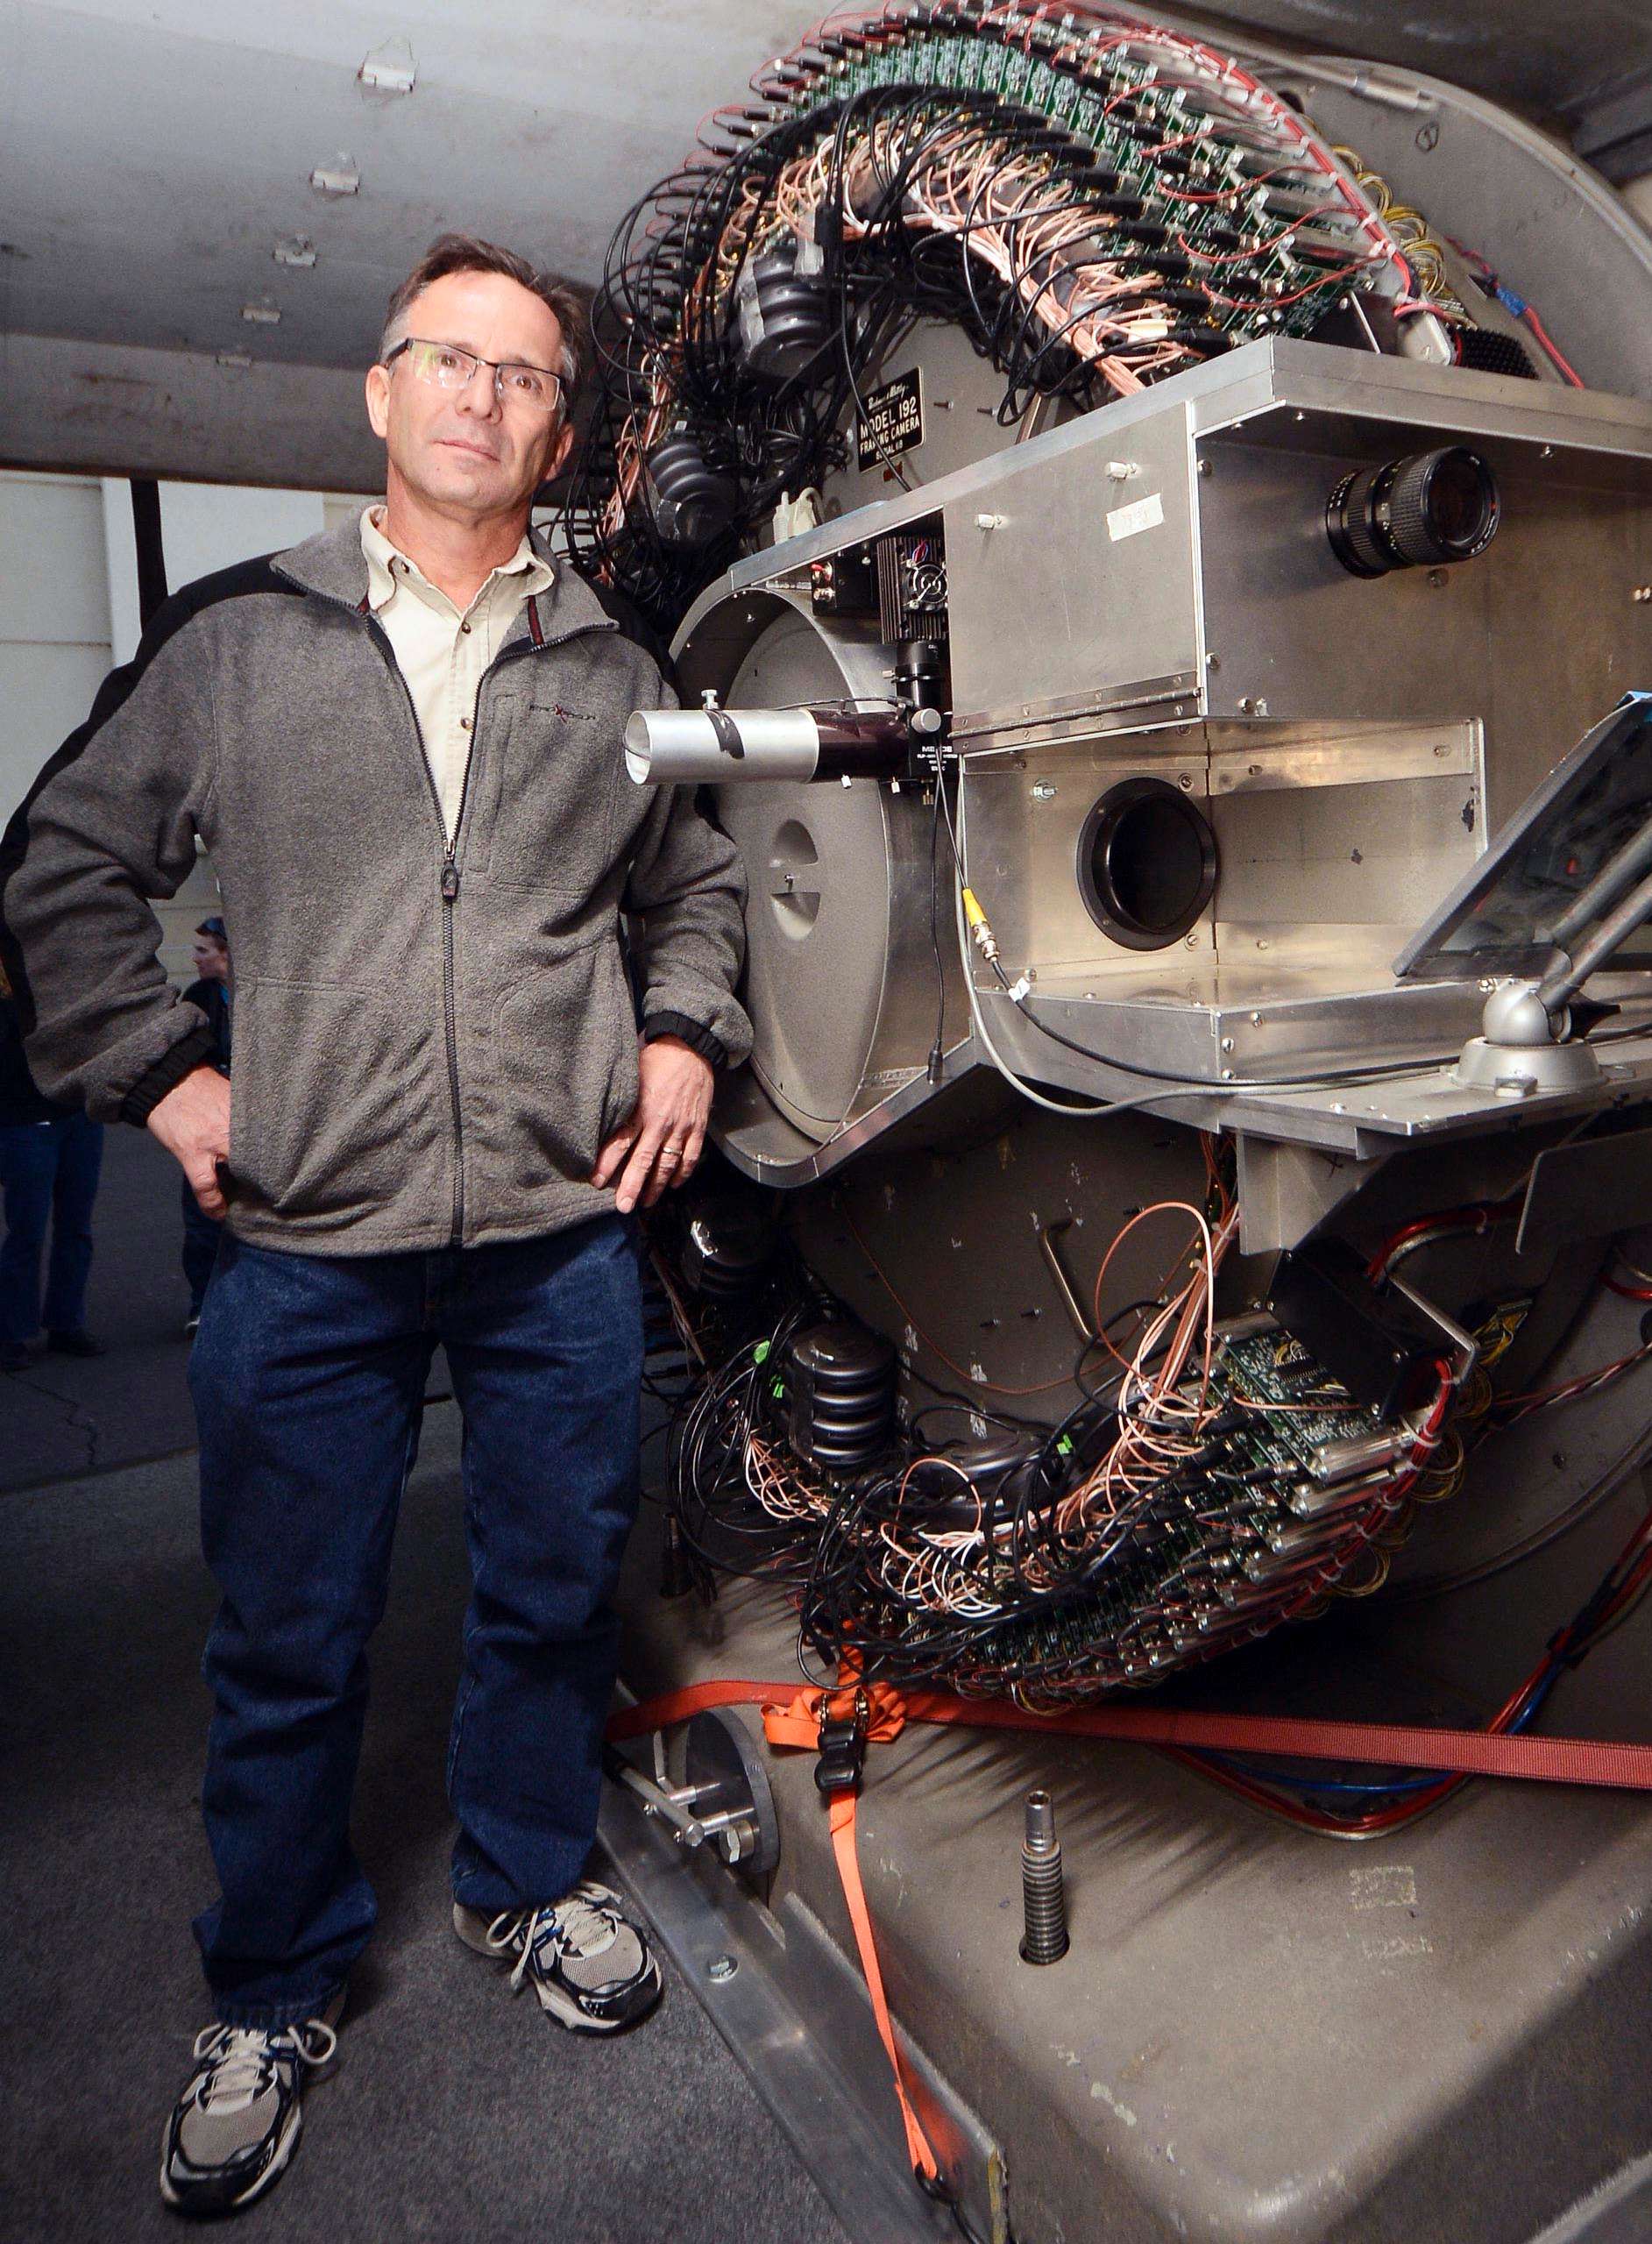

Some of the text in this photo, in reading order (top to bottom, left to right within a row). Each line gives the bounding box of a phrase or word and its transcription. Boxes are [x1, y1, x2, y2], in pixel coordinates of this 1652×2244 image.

[860, 408, 896, 440] MODEL
[899, 396, 918, 419] 192
[890, 415, 920, 440] CAMERA
